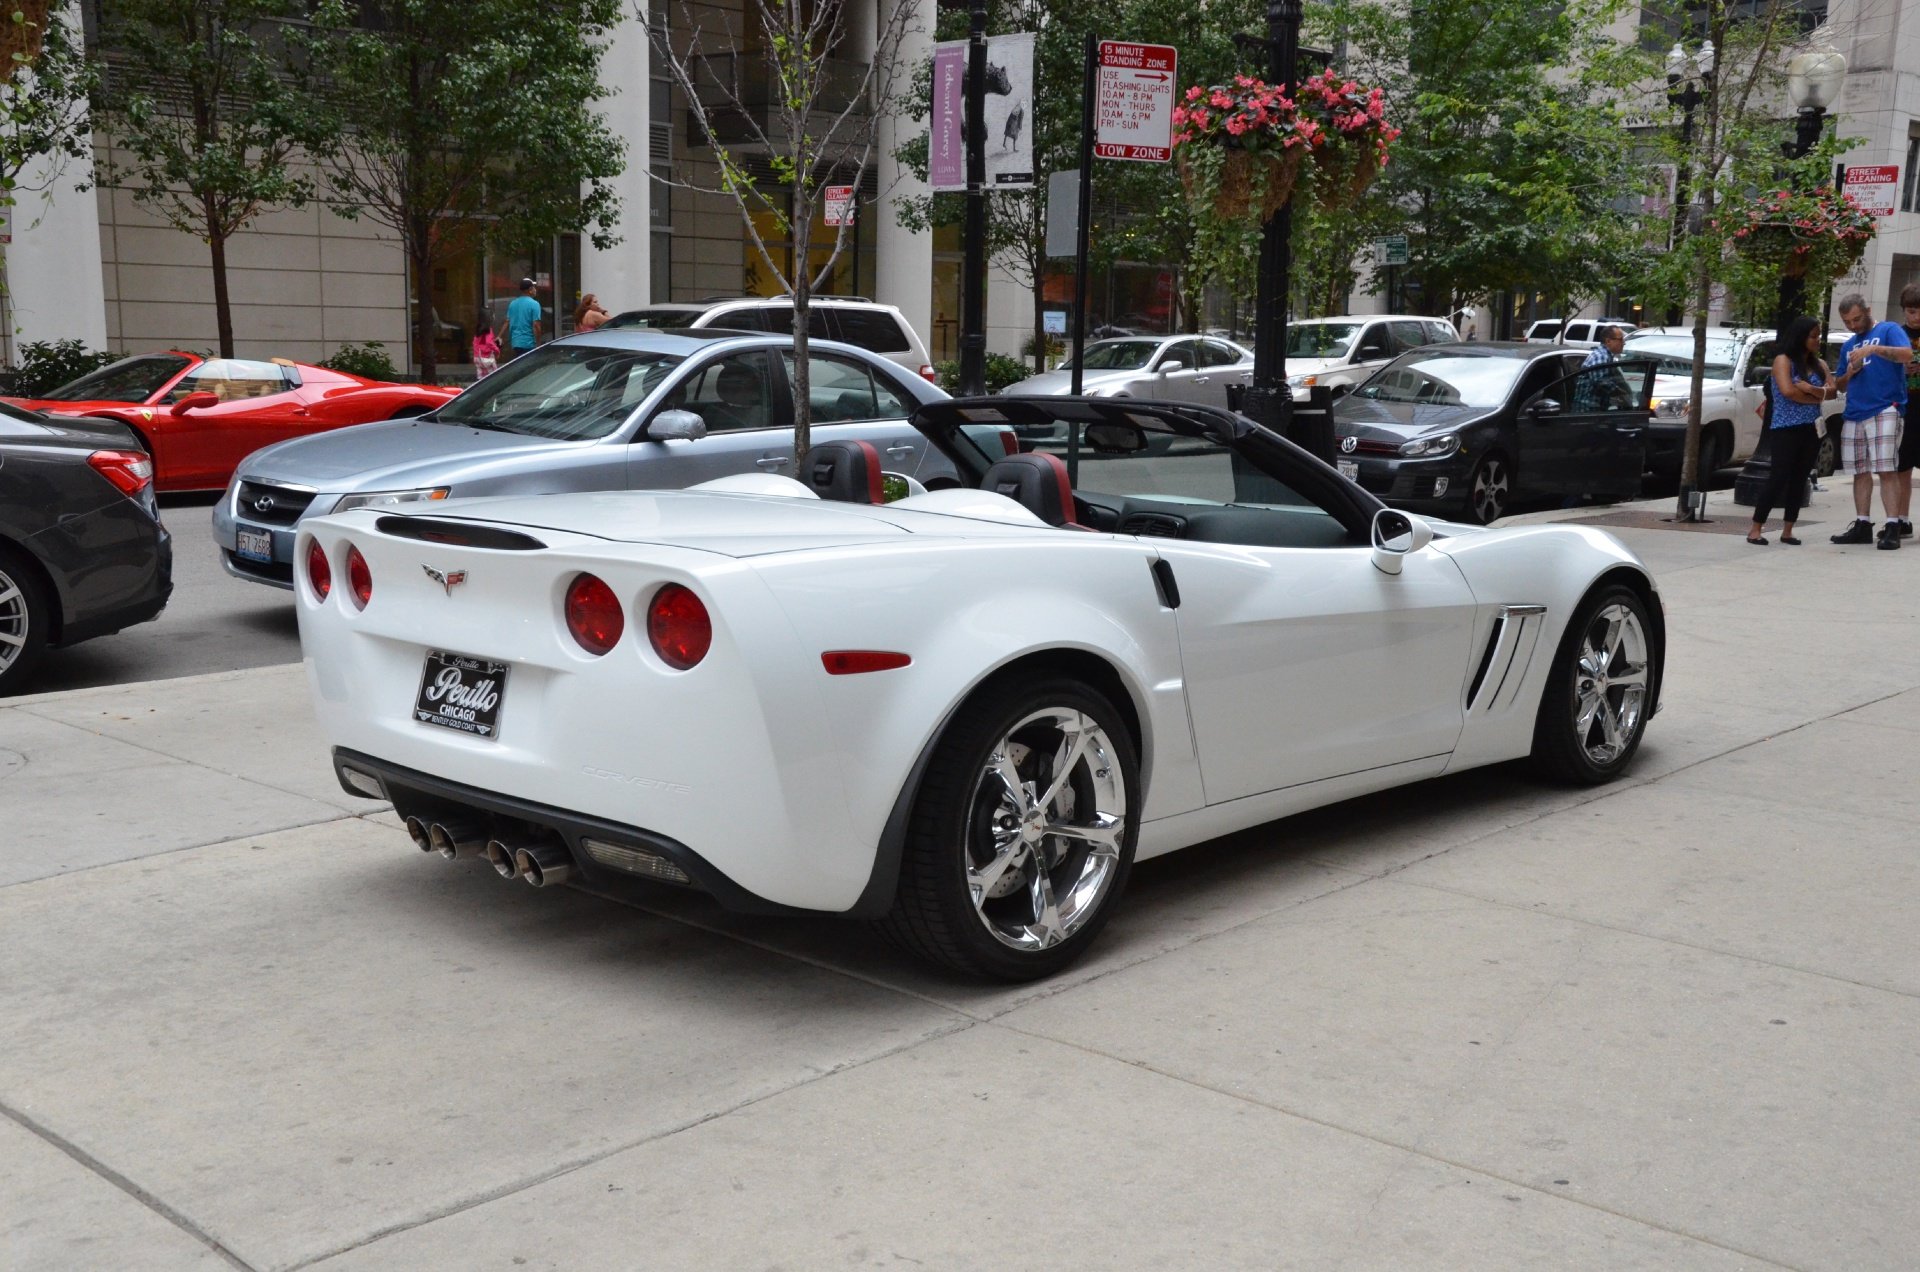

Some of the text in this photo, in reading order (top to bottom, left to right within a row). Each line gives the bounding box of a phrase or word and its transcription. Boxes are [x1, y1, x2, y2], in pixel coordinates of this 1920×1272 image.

[1104, 44, 1144, 57] 15 MINUTE
[1104, 55, 1167, 69] STANDING ZONE
[1103, 71, 1119, 80] USE
[1102, 81, 1170, 94] FLASHING LIGHTS
[1102, 100, 1120, 109] MON
[1129, 101, 1156, 112] THURS
[1100, 119, 1115, 128] FRI
[1122, 121, 1139, 130] SUN
[1100, 144, 1165, 159] TOW ZONE
[1849, 167, 1881, 176] STREET
[1848, 175, 1892, 183] CLEANING
[452, 656, 480, 669] Perillo
[425, 666, 498, 713] Perillo
[439, 703, 476, 721] CHICAGO
[431, 715, 476, 732] BENTLEY GOLD COAST
